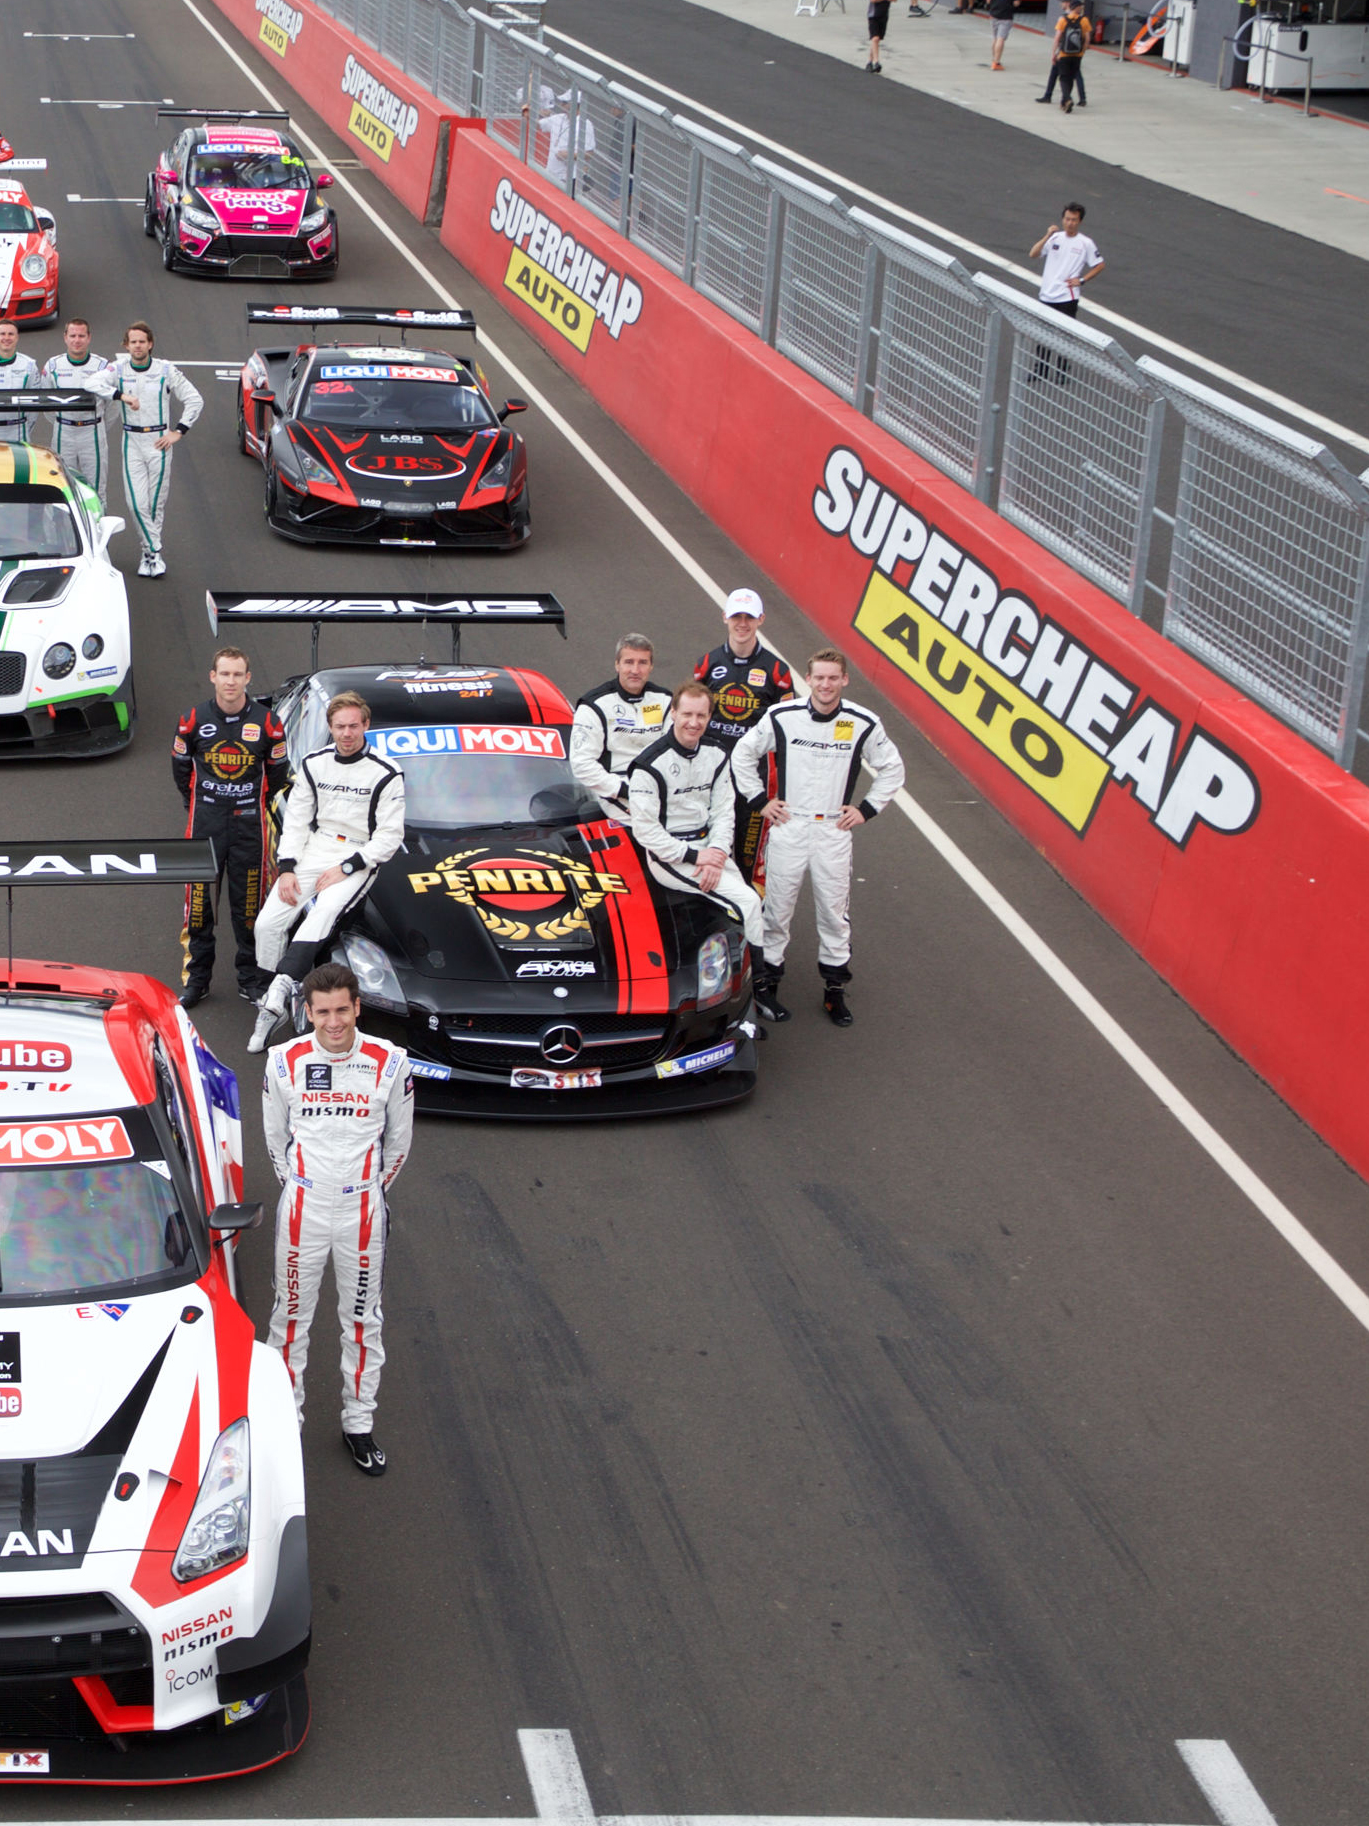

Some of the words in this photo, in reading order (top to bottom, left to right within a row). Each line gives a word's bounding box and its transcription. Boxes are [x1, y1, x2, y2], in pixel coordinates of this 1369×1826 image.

[262, 21, 284, 50] AUTO
[341, 53, 418, 148] SUPERCHEAP
[354, 112, 387, 151] AUTO
[201, 144, 243, 152] LIQUI
[245, 145, 288, 154] MOLY
[490, 178, 643, 340] SUPERCHEAP
[516, 266, 581, 331] AUTO
[325, 366, 389, 378] LIQUI
[391, 367, 455, 381] MOLY
[367, 456, 444, 471] JBS
[330, 600, 545, 613] AMG
[812, 445, 1261, 850] SUPERCHEAP
[403, 681, 493, 694] fitness
[882, 612, 1064, 778] AUTO
[713, 693, 761, 709] PENRITE
[710, 721, 751, 733] erebu
[370, 728, 458, 755] IQUI
[462, 728, 556, 753] MOLY
[811, 742, 851, 751] AMG
[204, 752, 256, 765] PENRITE
[202, 780, 254, 793] erebus
[333, 784, 371, 796] AMG
[246, 869, 259, 917] PENRITE
[407, 869, 631, 895] PENRITE
[191, 883, 204, 928] PENRITE
[685, 1045, 735, 1070] MICHELIN
[554, 1072, 598, 1088] STIX
[302, 1092, 369, 1104] NISSAN
[302, 1106, 369, 1117] nismo
[287, 1251, 300, 1315] NISSAN
[354, 1255, 370, 1317] nismo
[161, 1606, 232, 1645] NISSAN
[164, 1625, 233, 1662] nismo
